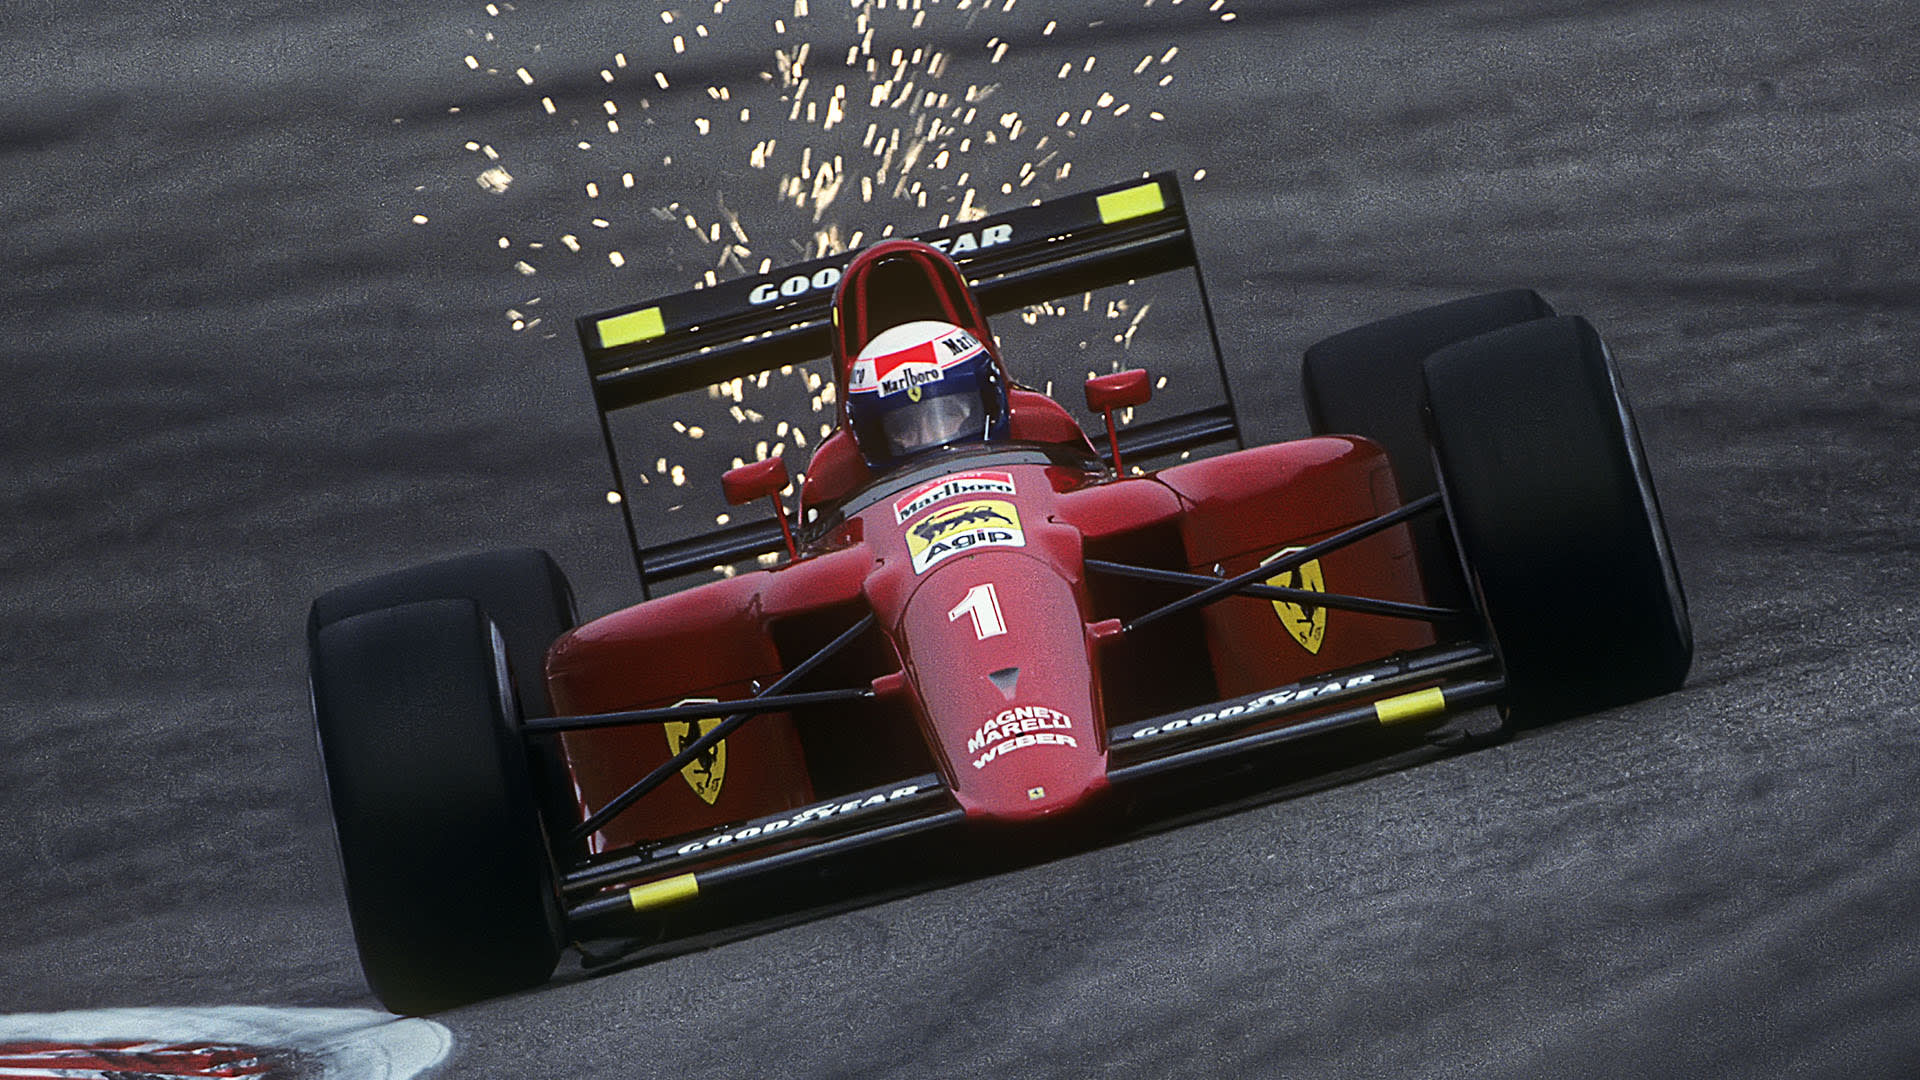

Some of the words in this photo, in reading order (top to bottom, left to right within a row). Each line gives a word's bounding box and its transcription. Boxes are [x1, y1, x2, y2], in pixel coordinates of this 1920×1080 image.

[882, 368, 940, 395] Marlboro
[900, 482, 1013, 521] Marlboro
[925, 529, 1013, 564] Agip
[948, 583, 1007, 640] 1
[1132, 674, 1375, 738] GOODYEAR
[968, 706, 1072, 753] MAGNETI
[968, 718, 1072, 753] MARELLI
[973, 733, 1077, 769] WEBER
[677, 785, 919, 855] GOODYEAR
